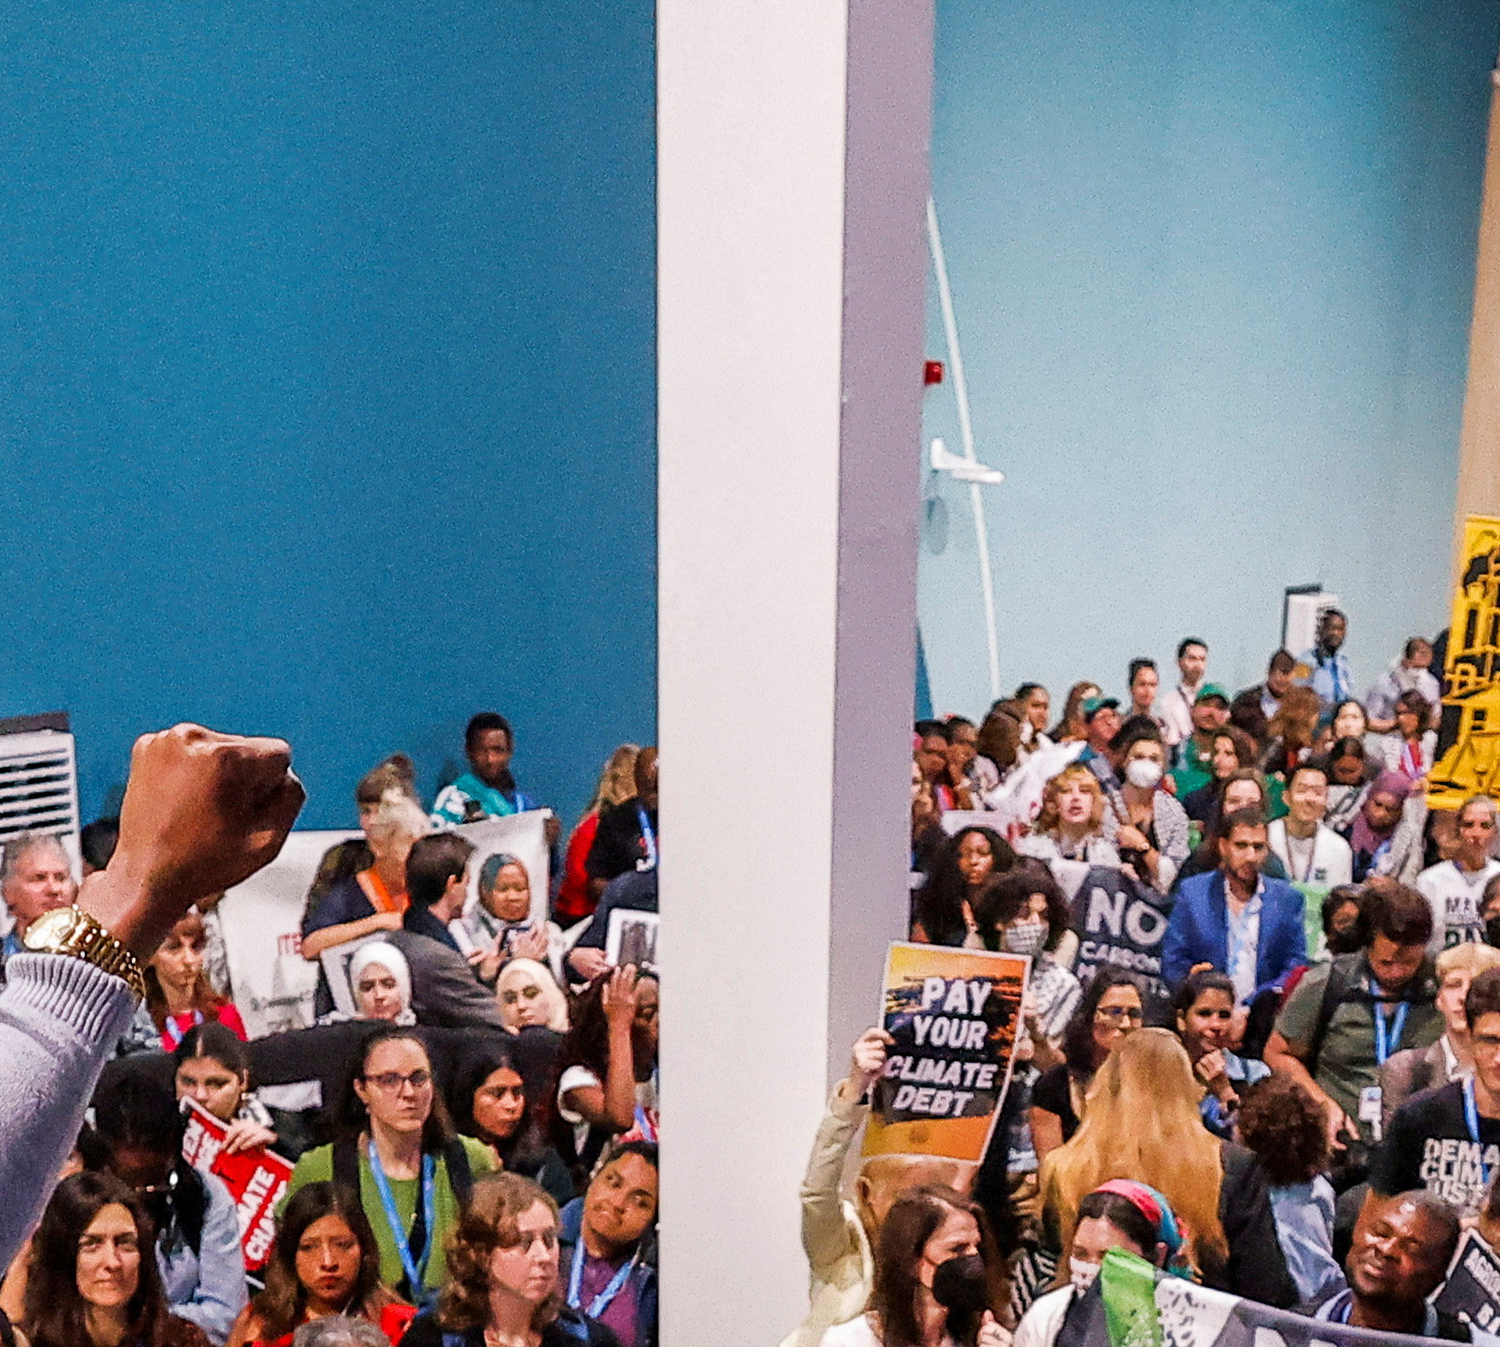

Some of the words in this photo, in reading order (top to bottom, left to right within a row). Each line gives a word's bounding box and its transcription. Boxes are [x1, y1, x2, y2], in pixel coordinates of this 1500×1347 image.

[1085, 886, 1169, 946] NO
[921, 976, 992, 1016] PAY
[913, 1014, 988, 1050] YOUR
[883, 1055, 999, 1089] CLIMATE
[892, 1085, 975, 1116] DEBT
